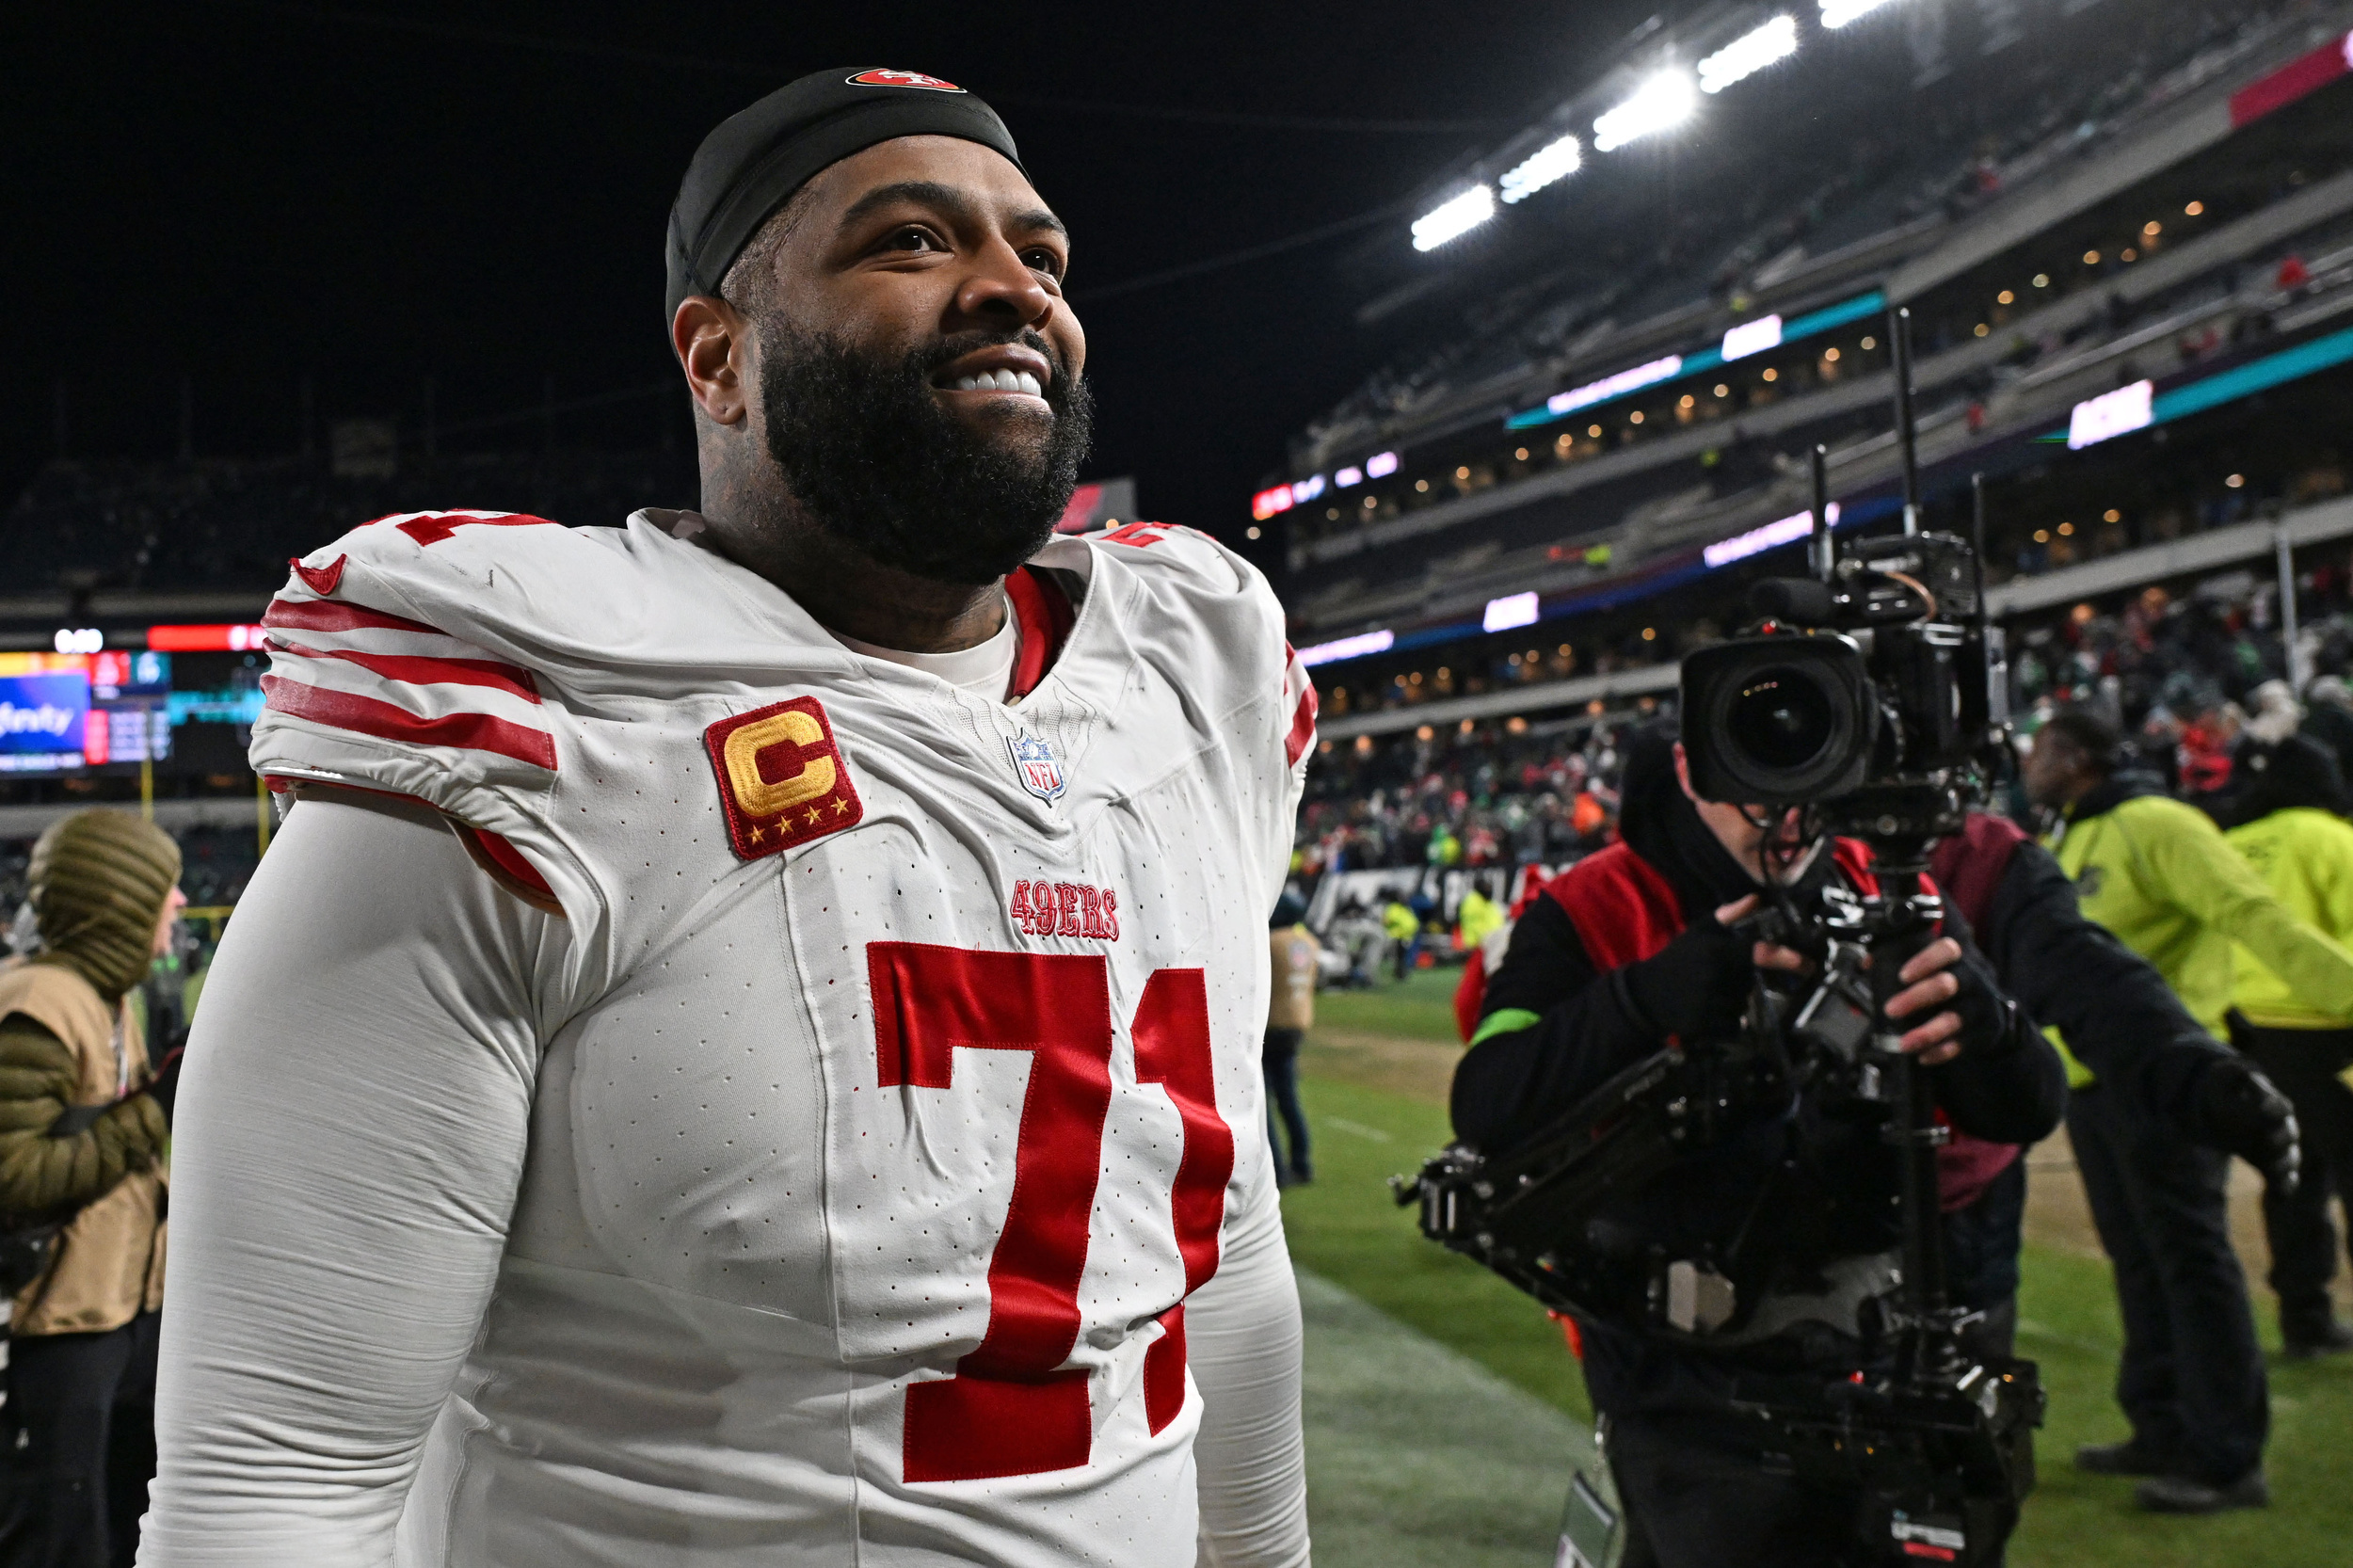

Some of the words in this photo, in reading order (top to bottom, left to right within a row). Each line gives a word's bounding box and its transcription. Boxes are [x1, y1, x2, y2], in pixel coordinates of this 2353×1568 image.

[724, 711, 837, 817] C
[1024, 762, 1061, 791] NFL
[1010, 880, 1120, 942] 49ERS
[866, 941, 1235, 1484] 71
